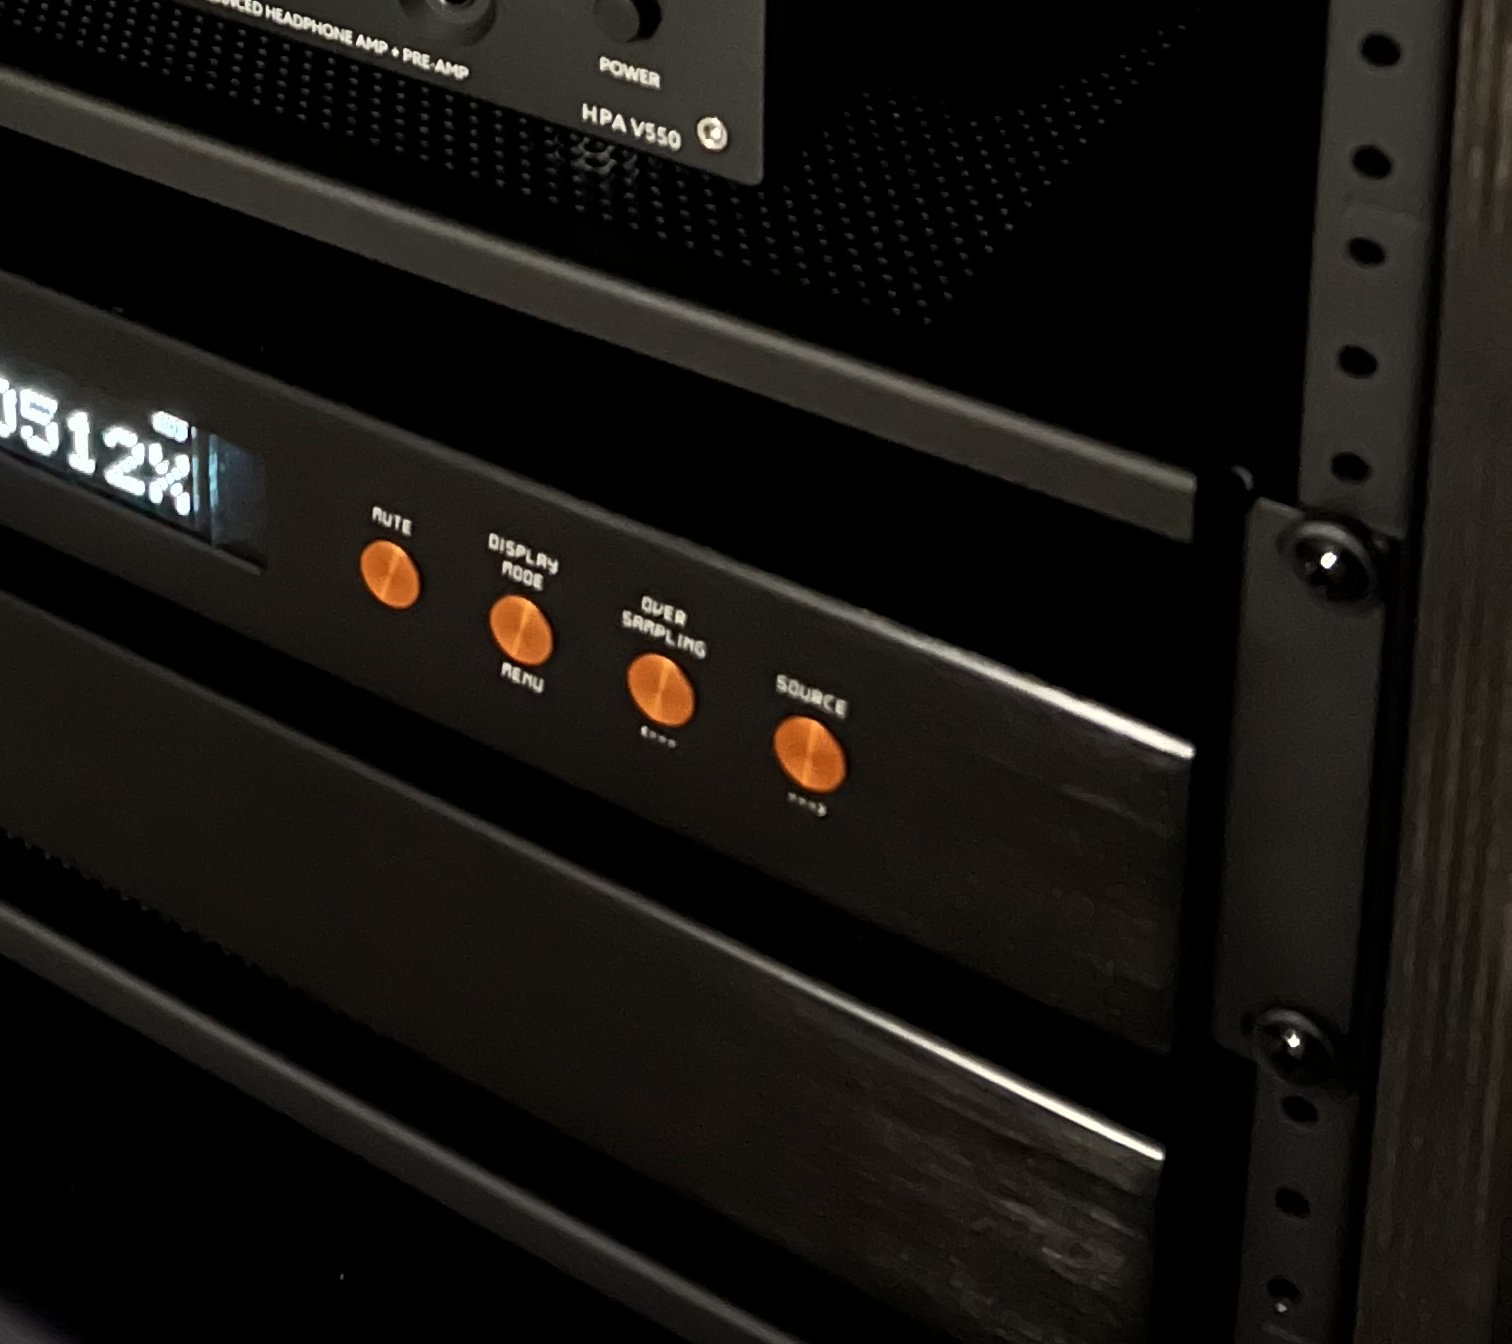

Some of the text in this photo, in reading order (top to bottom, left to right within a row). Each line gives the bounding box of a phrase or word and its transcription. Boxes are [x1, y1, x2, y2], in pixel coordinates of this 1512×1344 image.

[265, 4, 353, 46] HEADPHONE
[355, 33, 389, 55] AMP
[402, 47, 470, 80] PRE-AMP
[599, 56, 661, 89] POWER
[581, 103, 682, 151] HPA V550
[371, 506, 412, 536] MUTE
[488, 532, 559, 575] DISPLAY
[501, 560, 544, 591] MODE
[641, 595, 688, 627] OVER
[621, 610, 707, 659] SAMPLING
[501, 661, 545, 694] MENU
[776, 674, 847, 719] SOURCE
